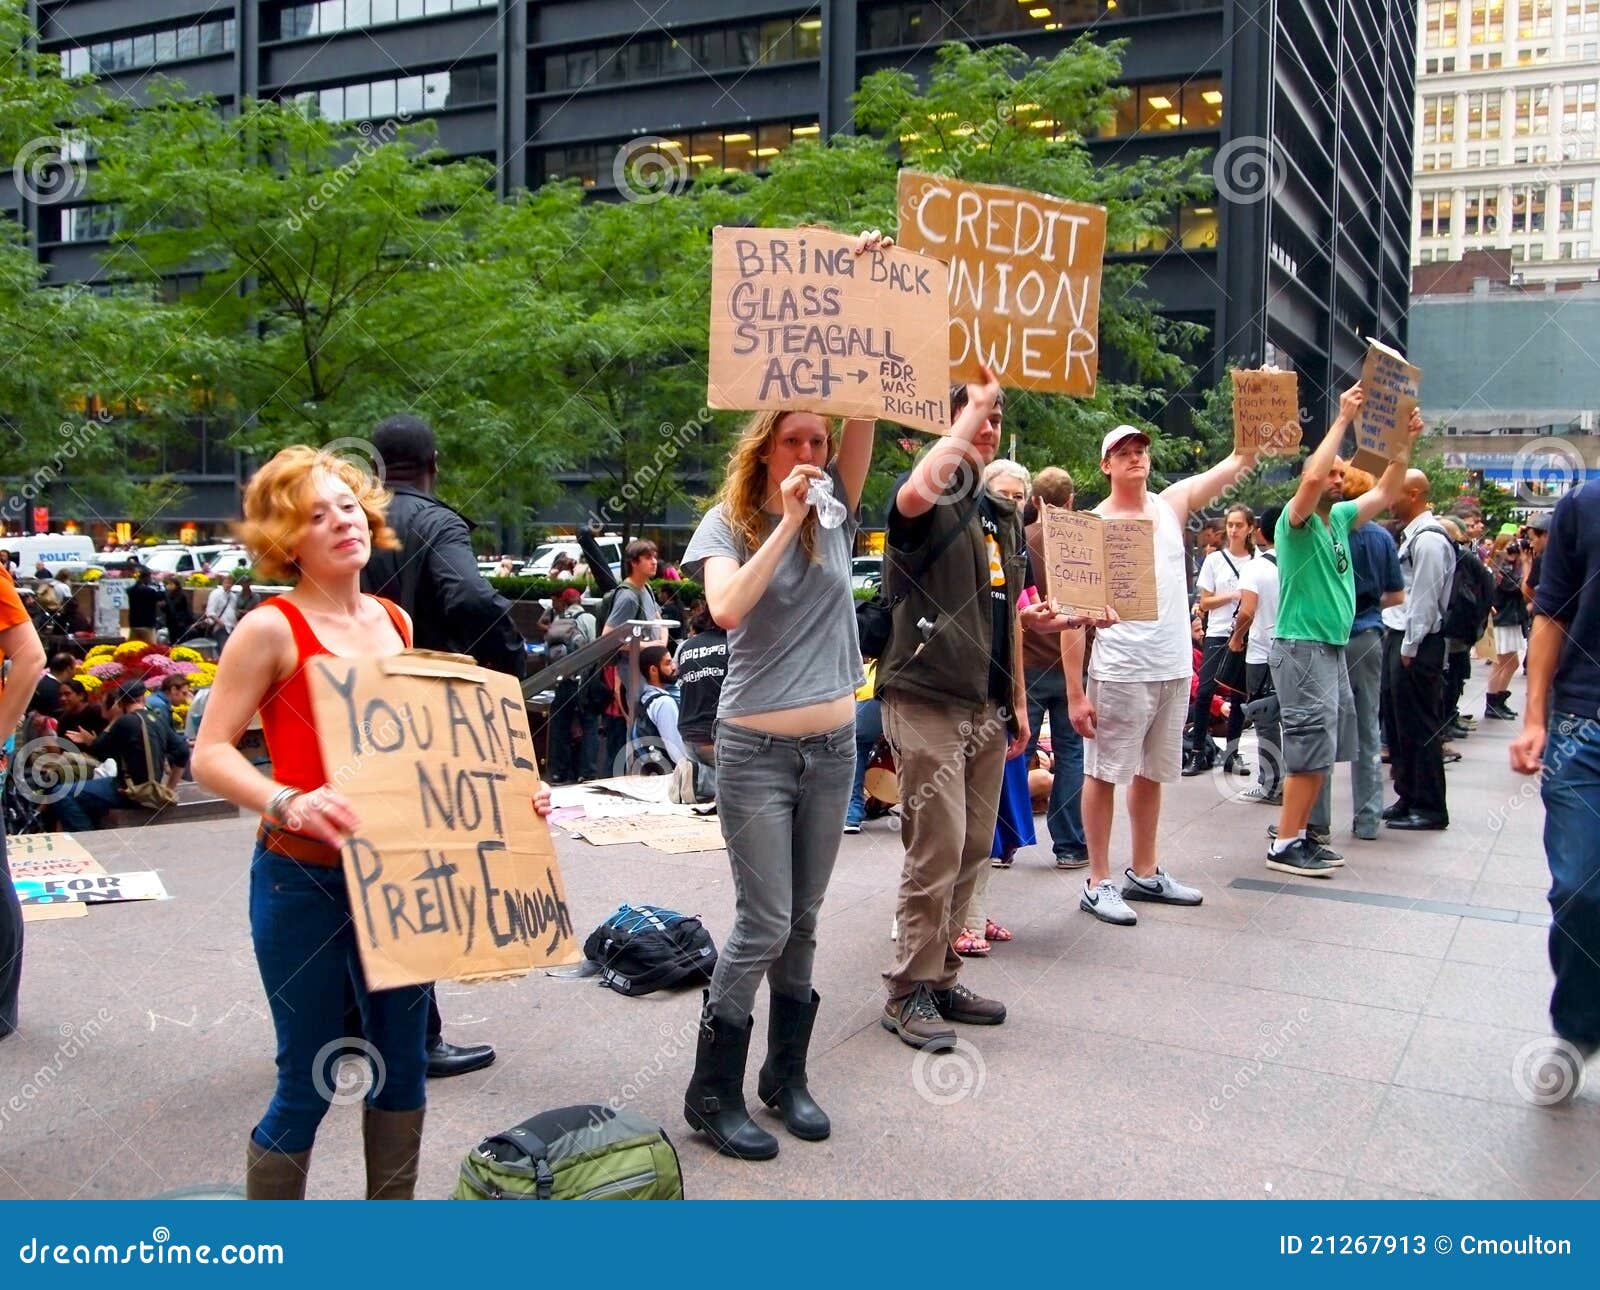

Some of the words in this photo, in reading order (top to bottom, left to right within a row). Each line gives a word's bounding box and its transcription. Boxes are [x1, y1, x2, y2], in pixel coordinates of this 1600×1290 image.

[916, 186, 1090, 266] CREDIT
[869, 249, 931, 295] BACK
[730, 282, 842, 323] GLASS
[733, 322, 906, 363] STEAGALL
[948, 316, 1097, 386] OWER
[881, 380, 916, 398] WAS
[882, 396, 945, 425] RIGHT!
[1049, 526, 1085, 542] DAVID
[1056, 542, 1095, 561] BEAT
[1054, 564, 1102, 586] GOLIATH
[316, 660, 434, 755] YOU
[446, 679, 535, 772] ARE
[415, 759, 507, 839] NOT
[44, 876, 121, 893] FOR
